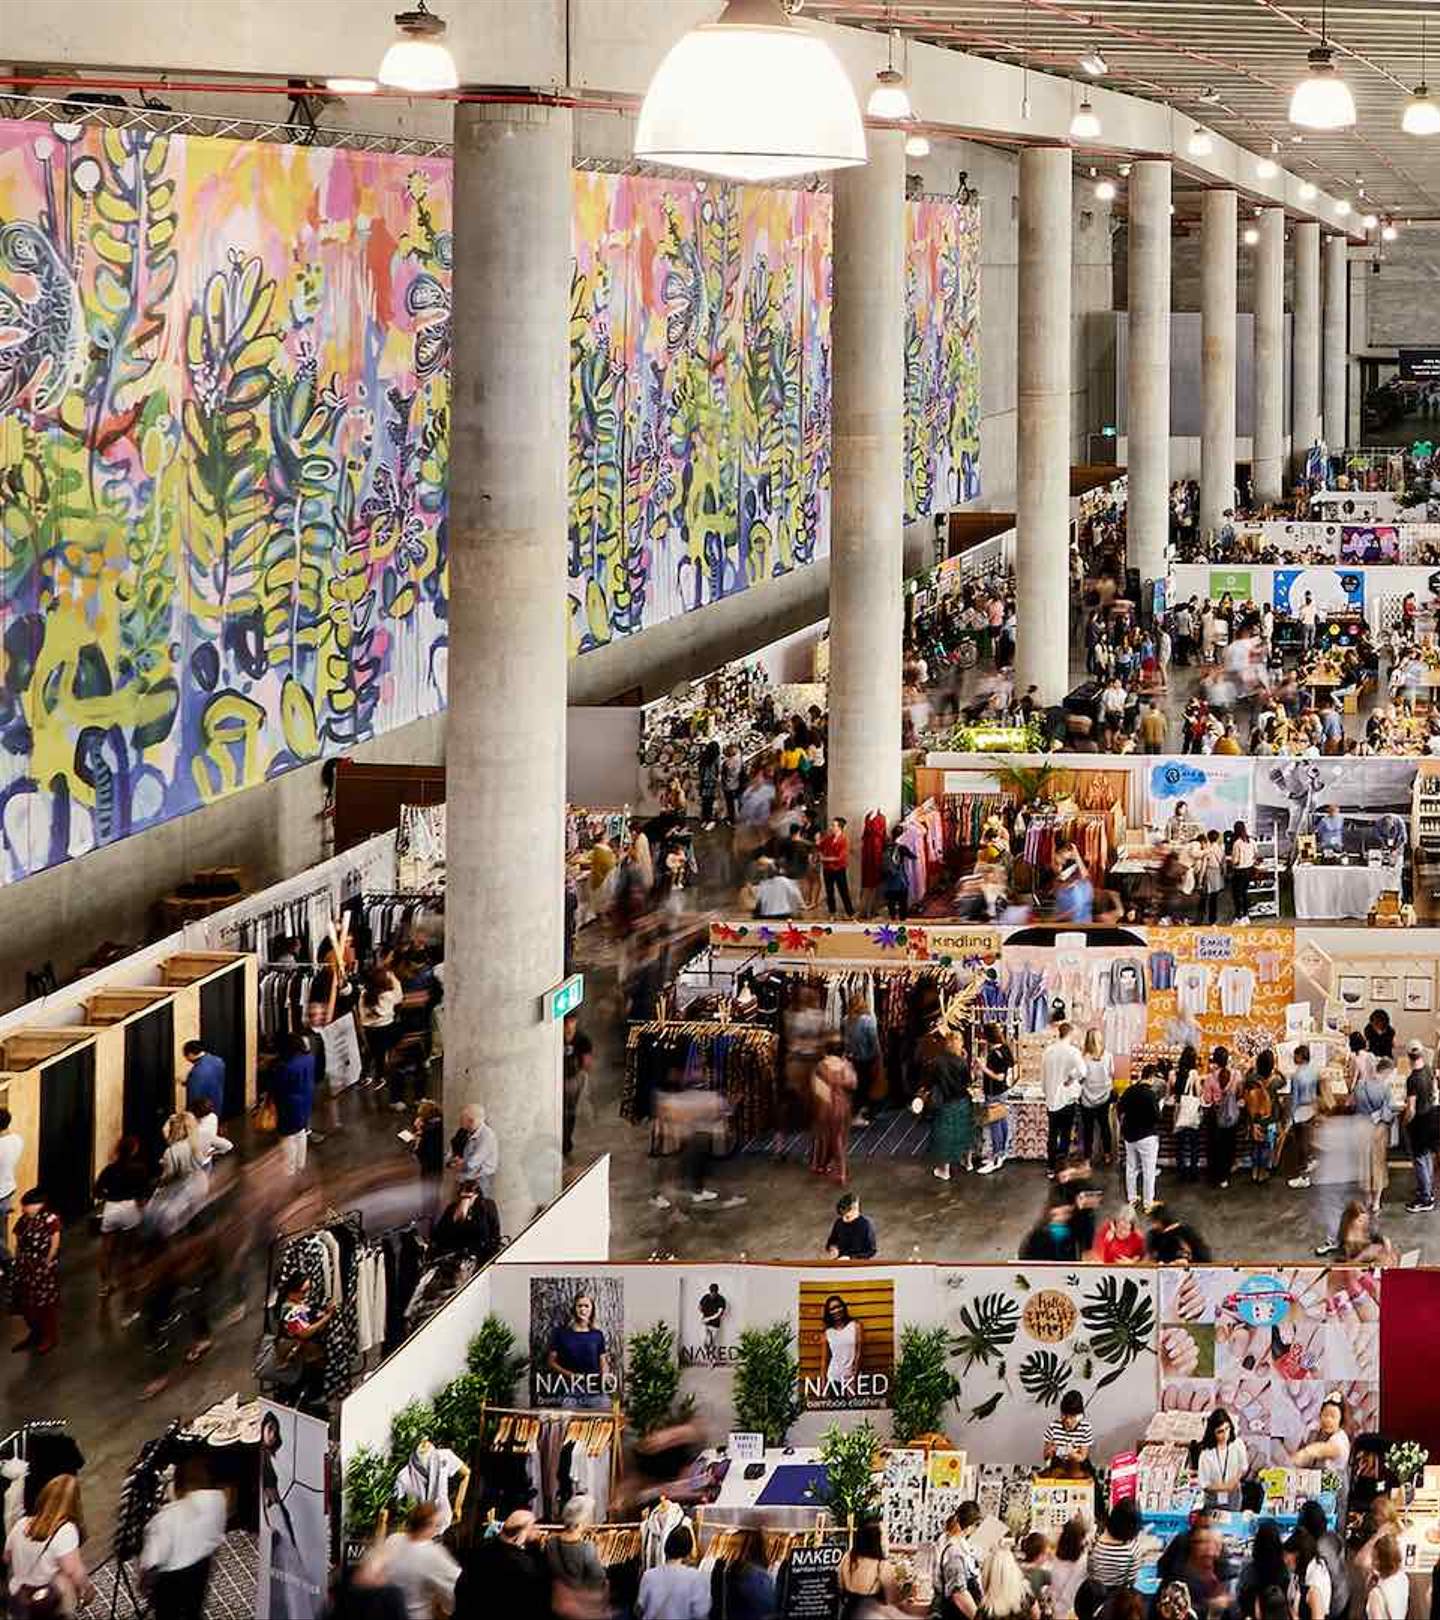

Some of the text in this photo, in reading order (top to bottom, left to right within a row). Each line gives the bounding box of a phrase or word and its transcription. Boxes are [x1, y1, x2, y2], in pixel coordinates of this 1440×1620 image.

[933, 934, 992, 949] Kindling
[682, 1345, 745, 1361] NAKED
[536, 1372, 618, 1394] NAKED
[804, 1374, 889, 1398] NAKED
[791, 1548, 843, 1566] NAKED
